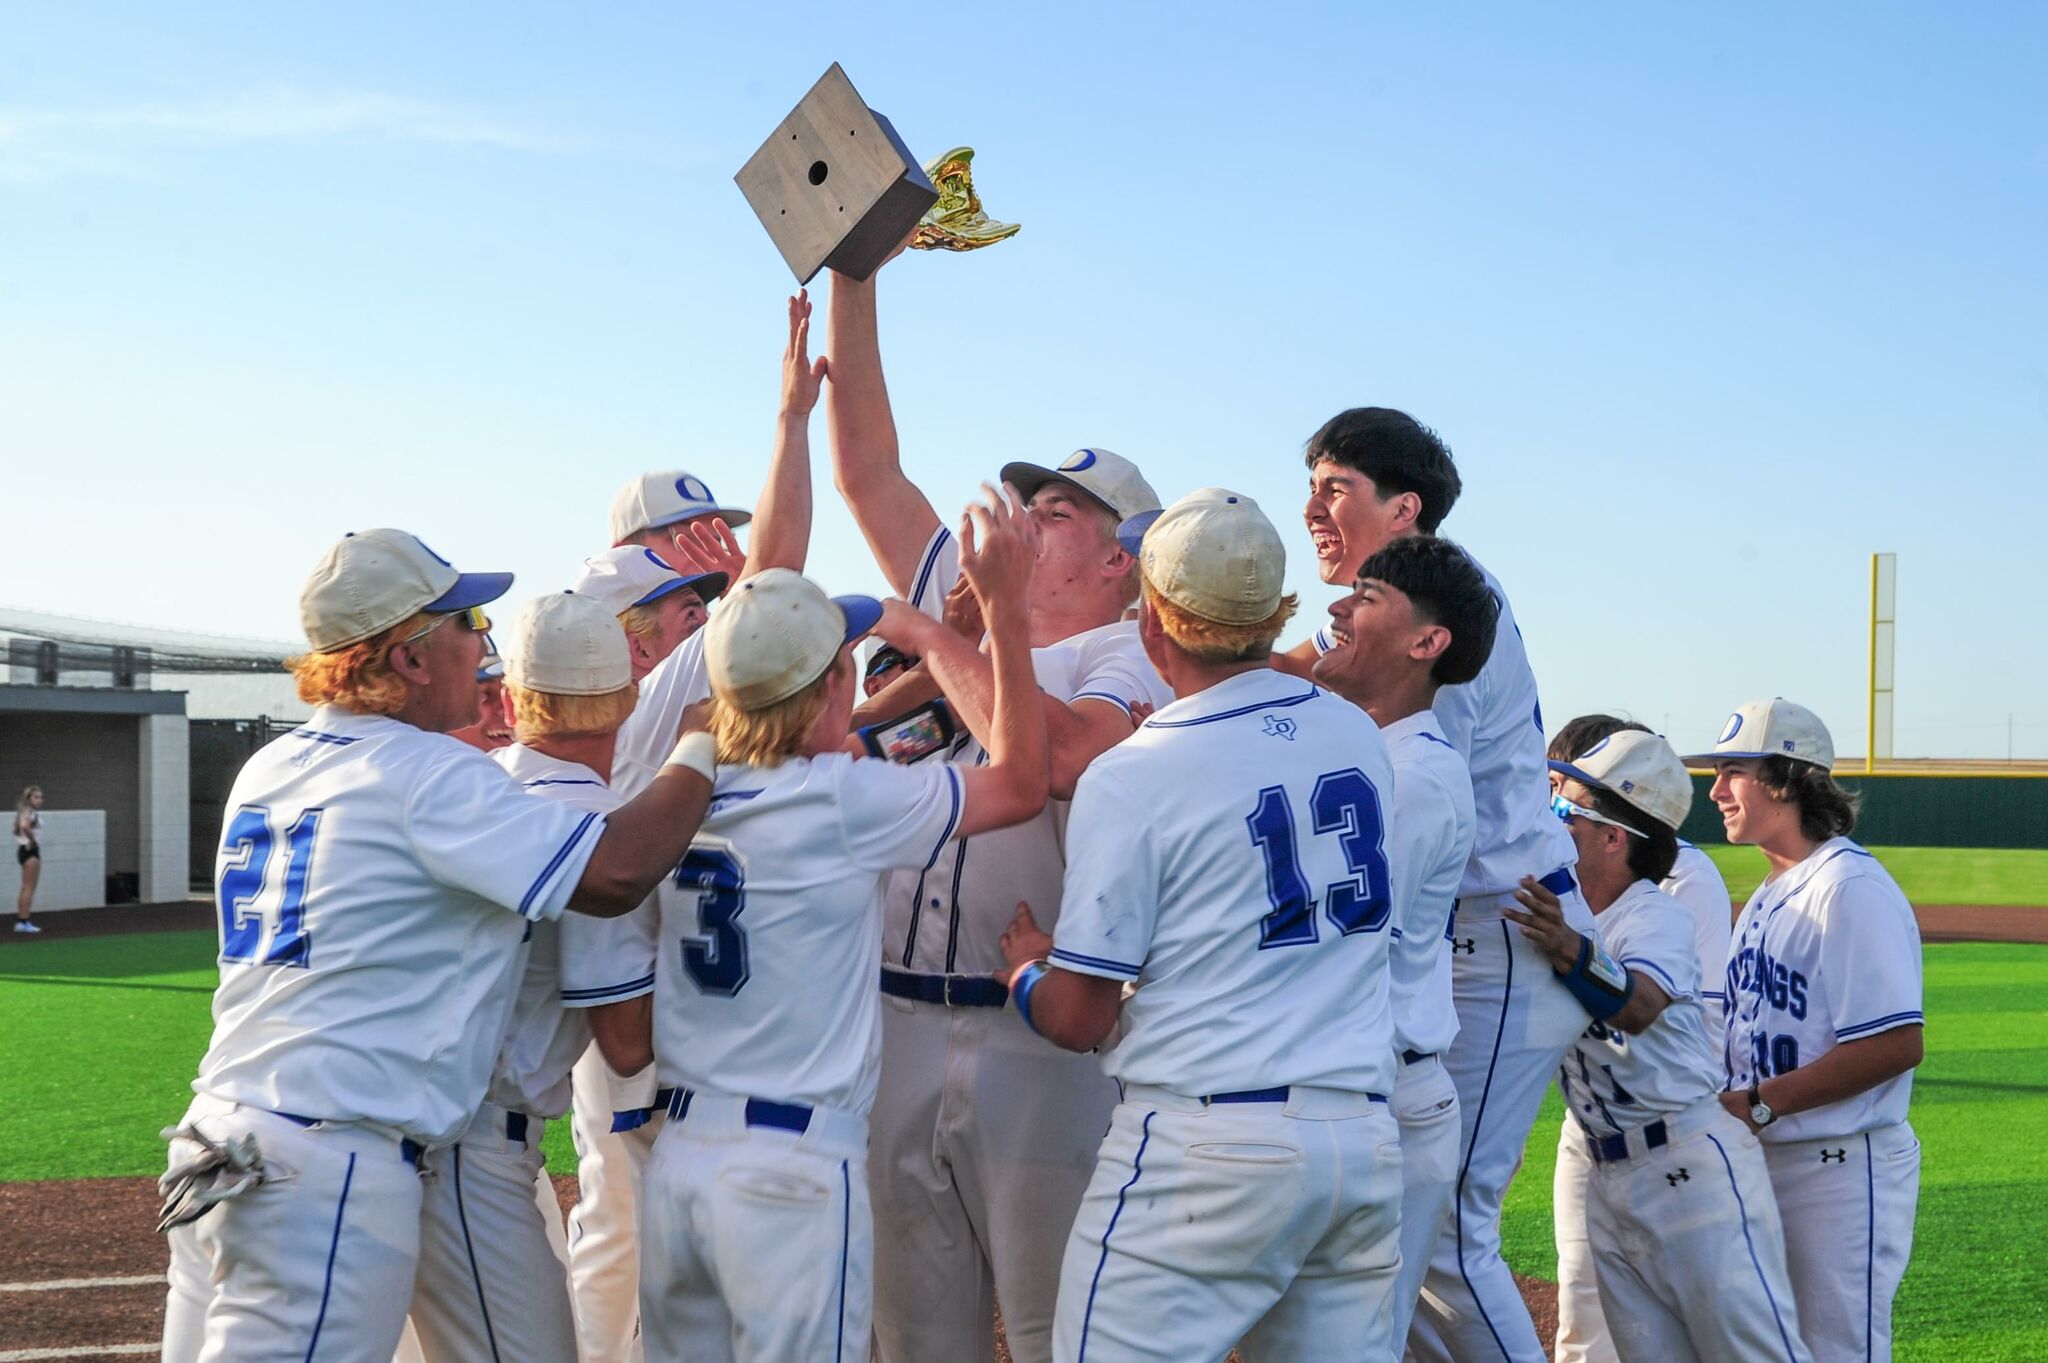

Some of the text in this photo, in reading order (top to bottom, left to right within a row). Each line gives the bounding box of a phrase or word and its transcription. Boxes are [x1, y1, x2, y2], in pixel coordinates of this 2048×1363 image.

[219, 804, 324, 968] 21
[673, 841, 752, 998] 3
[1246, 767, 1391, 951] 13
